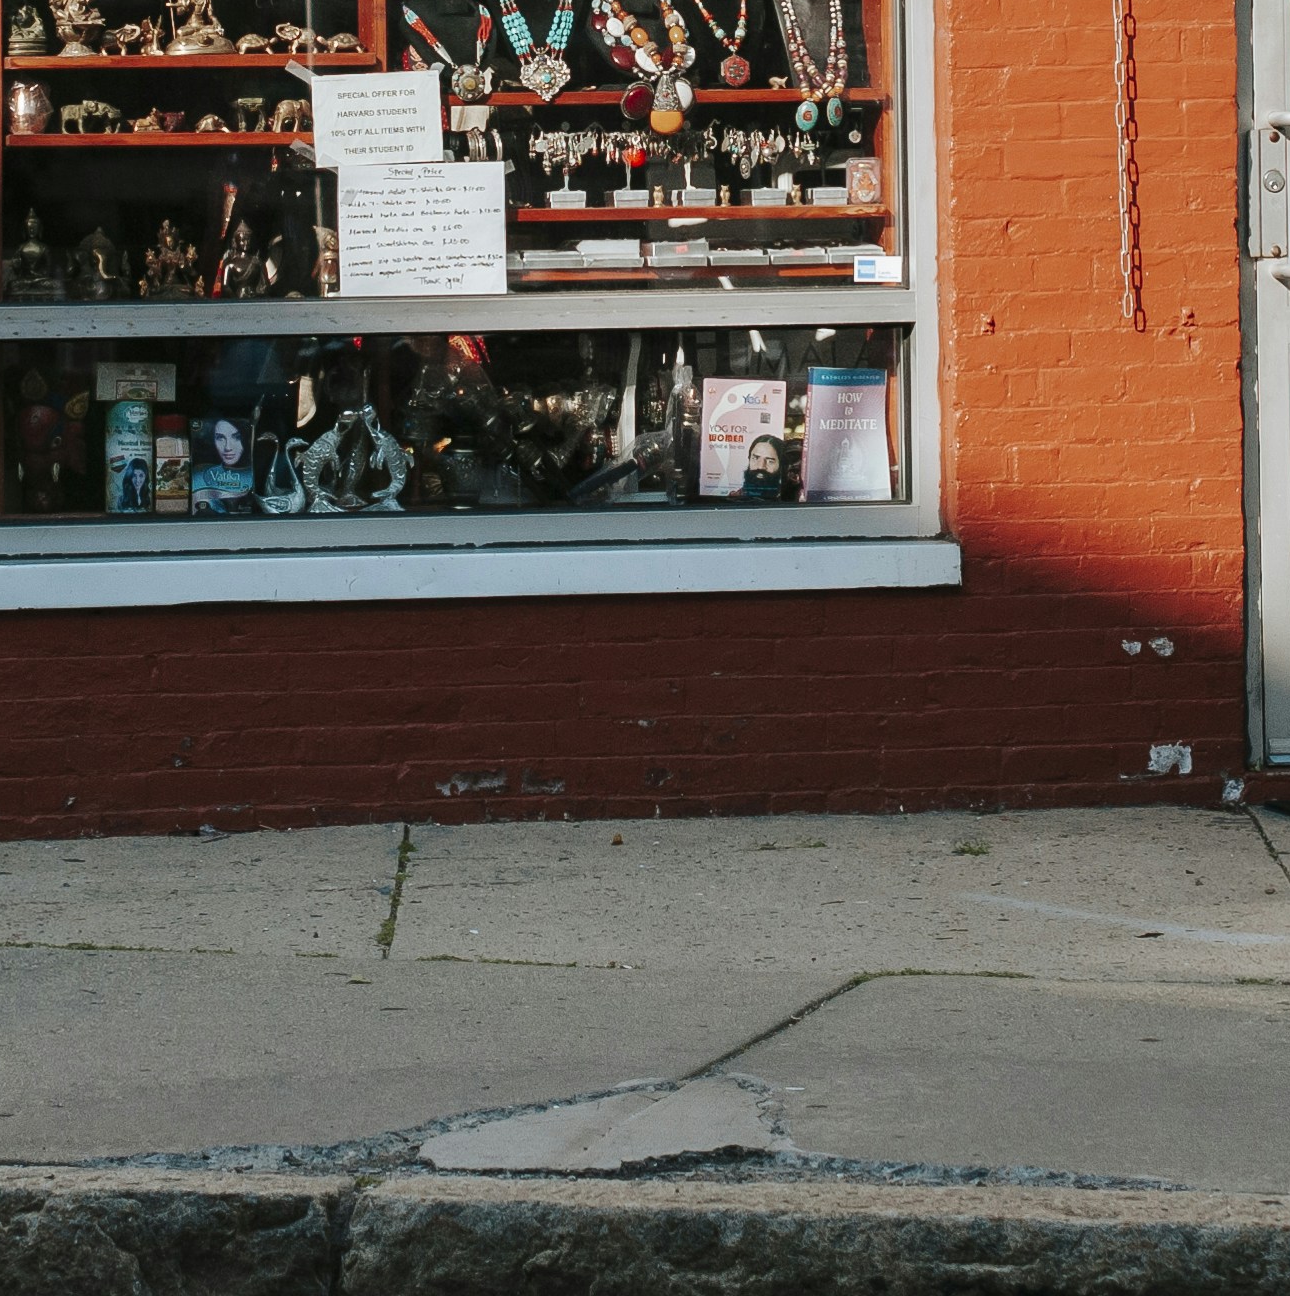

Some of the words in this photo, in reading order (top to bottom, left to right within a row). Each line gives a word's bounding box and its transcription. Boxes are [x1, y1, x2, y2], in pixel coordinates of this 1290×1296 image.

[337, 91, 370, 100] SPECIAL
[372, 90, 398, 98] OFFER
[337, 109, 375, 118] HARVARD
[376, 107, 418, 116] STUDENTS
[365, 128, 379, 136] ALL
[369, 145, 404, 154] STUDENT
[406, 144, 414, 152] ID
[388, 167, 414, 176] Special
[421, 167, 443, 175] Price
[413, 276, 441, 285] Thank
[837, 392, 864, 404] HOW
[844, 406, 854, 416] to
[709, 424, 729, 433] YOG
[819, 418, 878, 430] MEDITATE
[210, 470, 240, 481] Vatika
